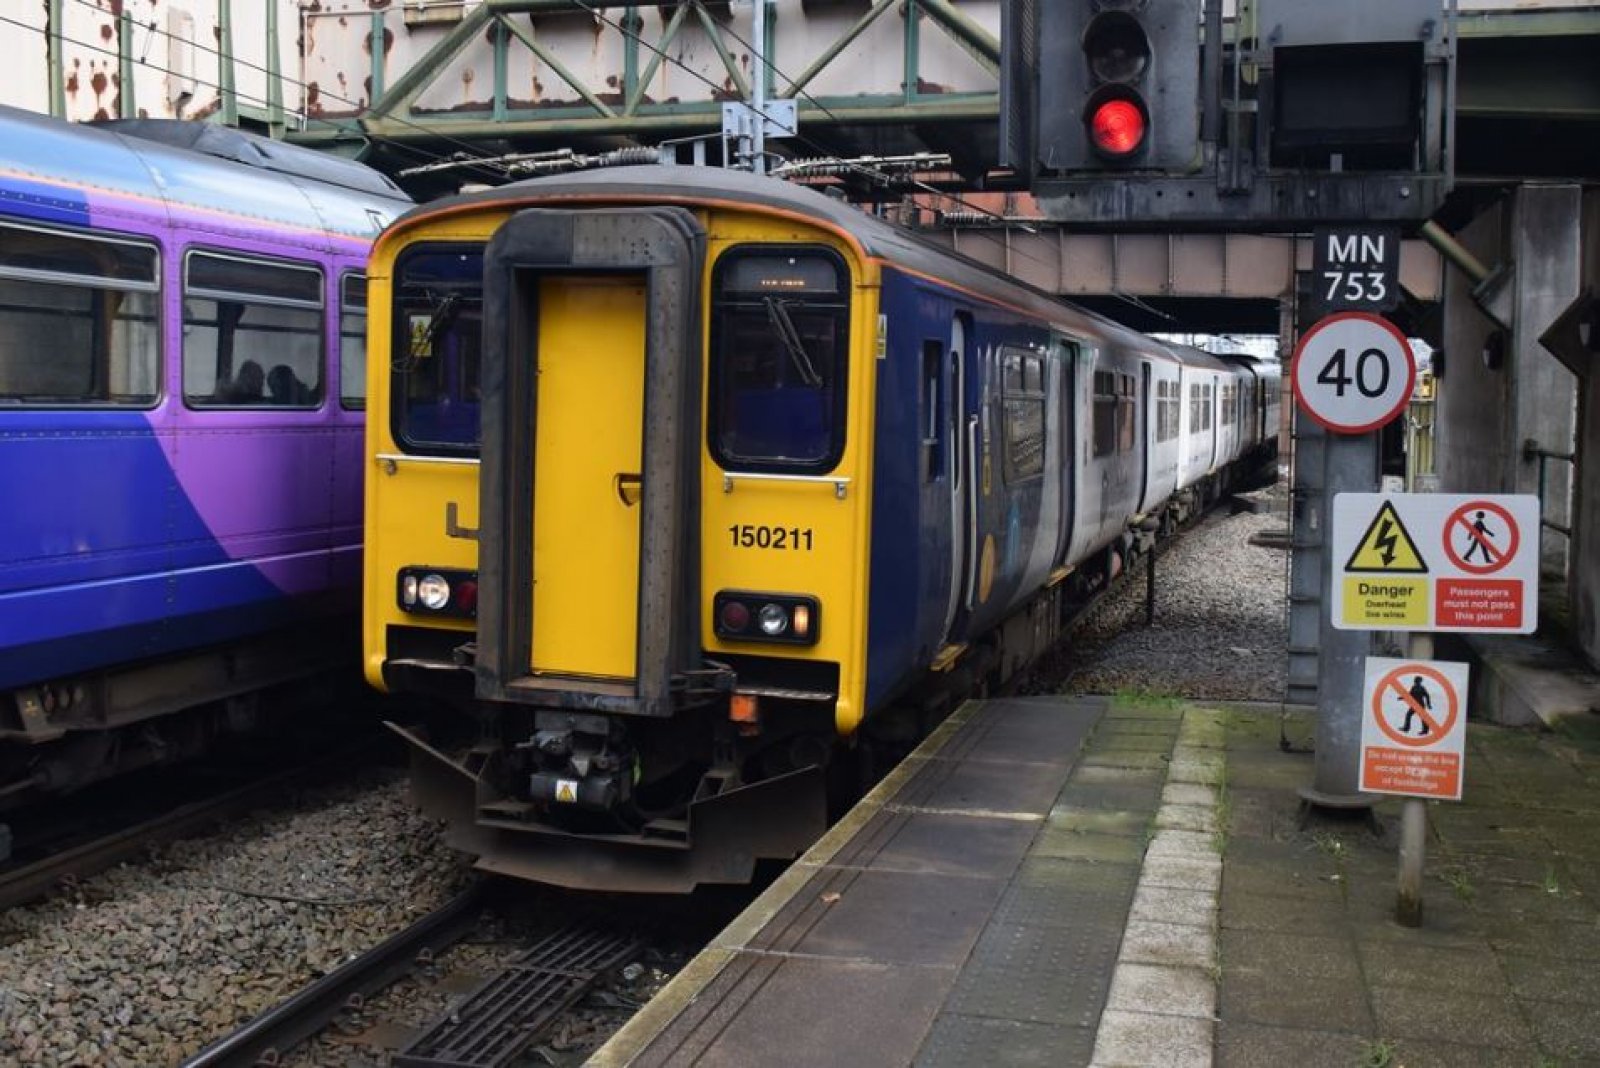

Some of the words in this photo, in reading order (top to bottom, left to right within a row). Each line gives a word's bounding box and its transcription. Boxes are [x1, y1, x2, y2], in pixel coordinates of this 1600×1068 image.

[1327, 234, 1385, 263] MN
[1323, 271, 1386, 301] 753
[1317, 348, 1390, 398] 40
[728, 523, 813, 551] 150211
[1359, 583, 1414, 598] Danger
[1450, 587, 1510, 598] Passengers
[1365, 600, 1407, 609] Overhead
[1443, 600, 1469, 609] must
[1470, 600, 1489, 609] not
[1490, 601, 1516, 611] pass
[1455, 611, 1475, 621] this
[1476, 611, 1504, 622] point
